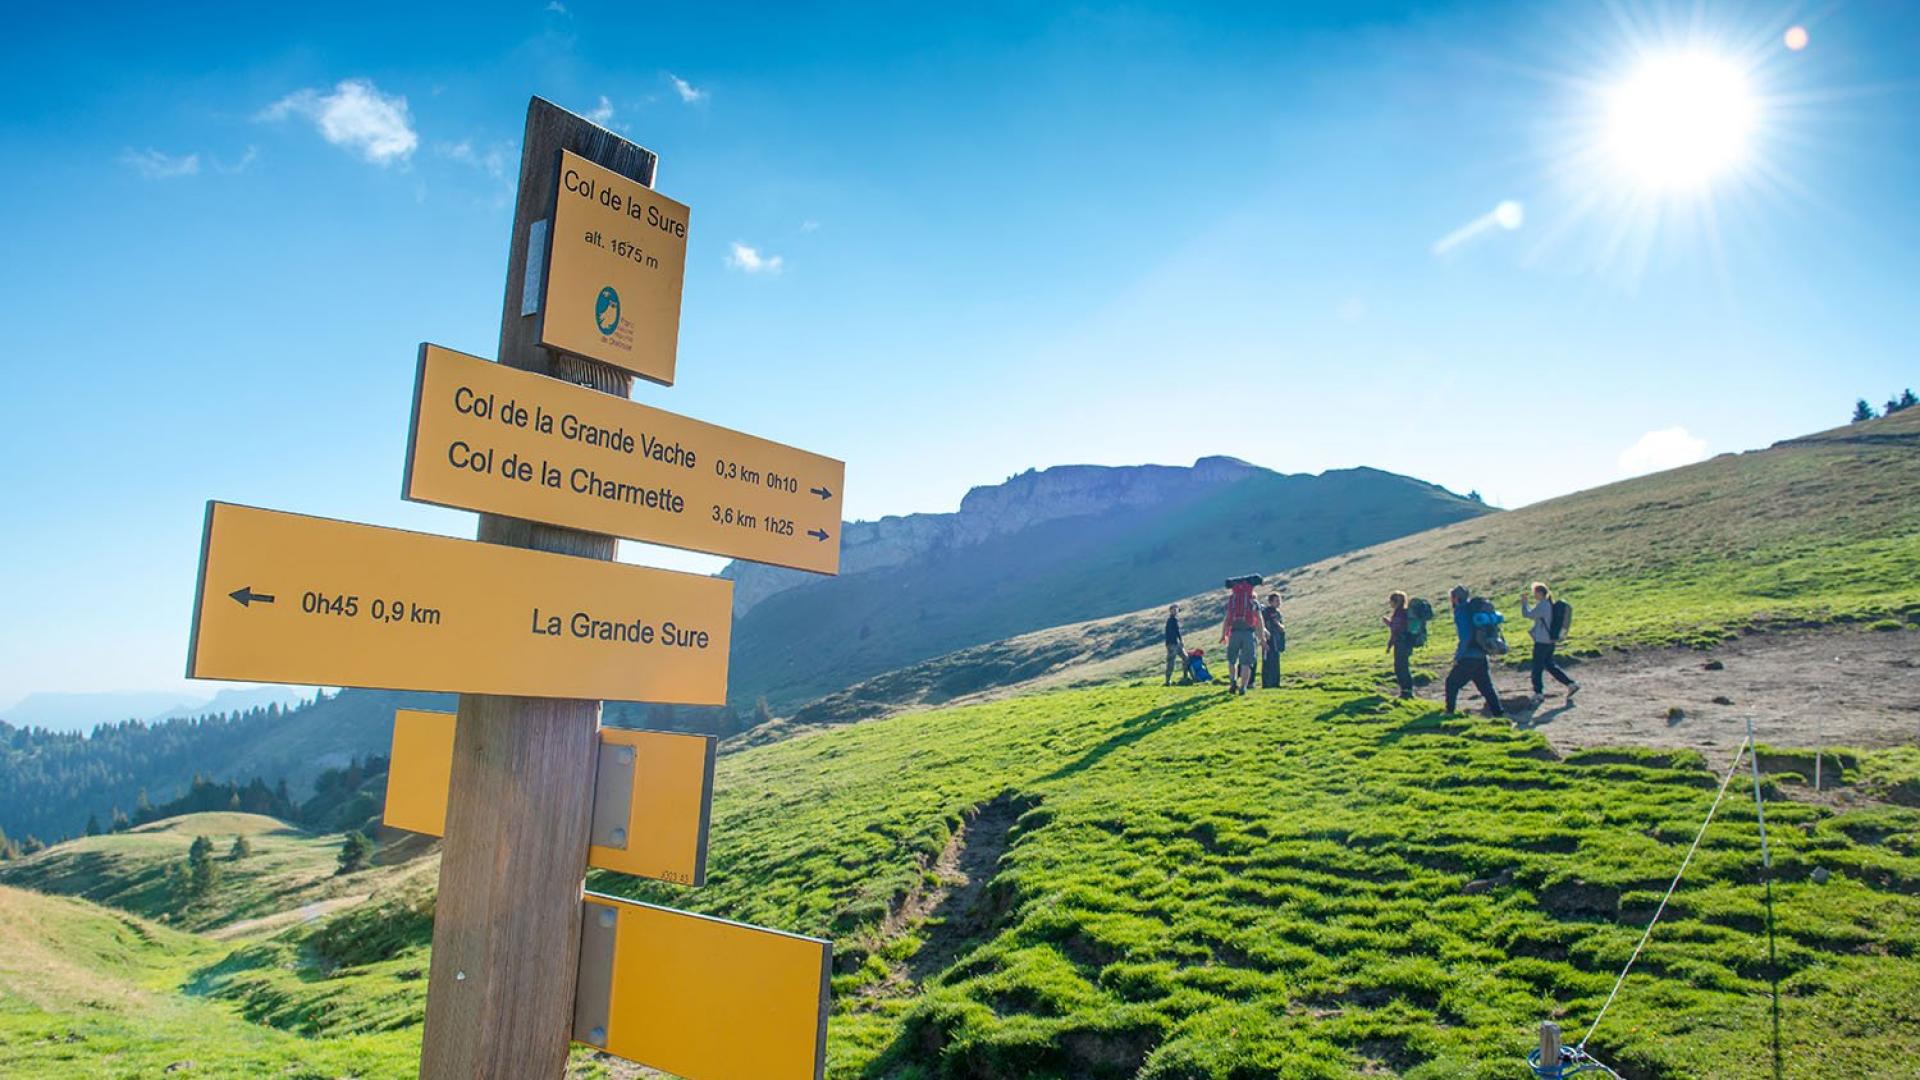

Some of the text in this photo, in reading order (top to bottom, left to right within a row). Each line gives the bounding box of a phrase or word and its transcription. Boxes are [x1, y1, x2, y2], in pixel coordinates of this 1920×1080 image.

[565, 170, 686, 238] Col de la Sure
[584, 231, 658, 269] alt. 1675 m
[455, 387, 797, 493] Col de la Grande Vache 0,3 km 0h10
[448, 441, 794, 536] Col de la Charmette 3,6 km 1h25
[302, 592, 709, 648] 0h45 0,9 km La Grande Sure
